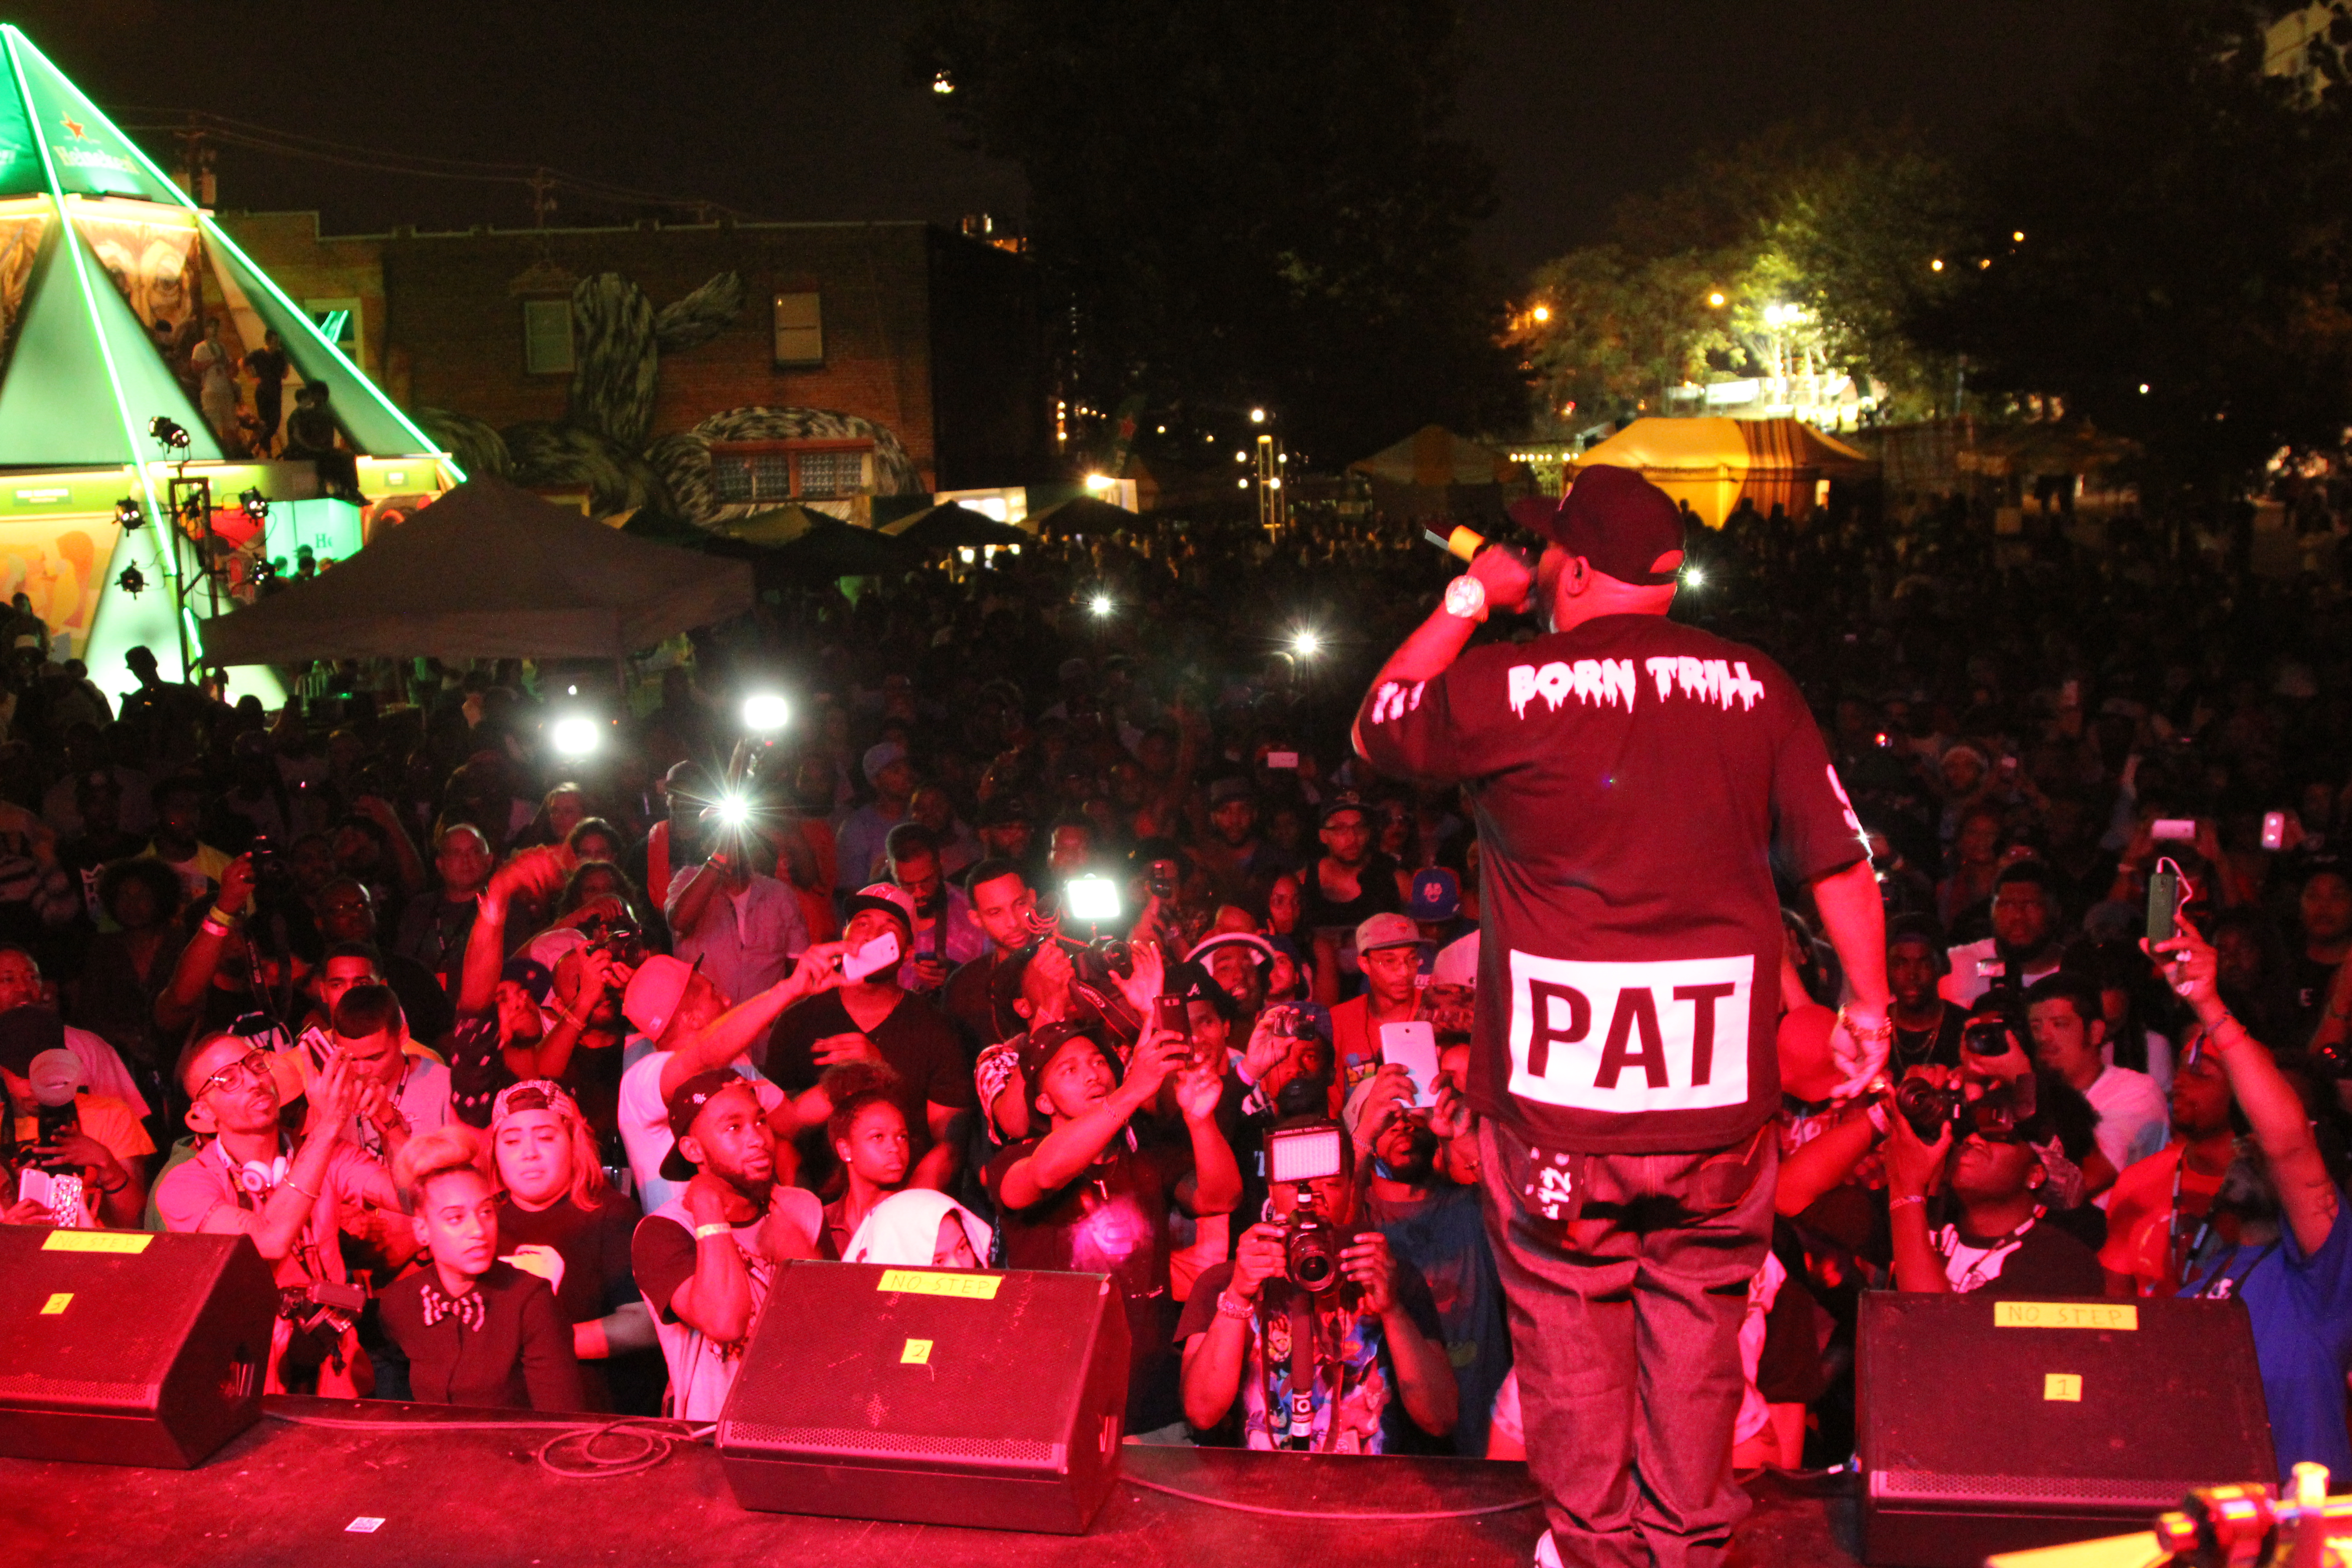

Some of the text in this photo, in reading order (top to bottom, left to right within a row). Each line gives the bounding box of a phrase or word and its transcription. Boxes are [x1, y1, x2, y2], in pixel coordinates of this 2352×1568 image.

[53, 146, 140, 176] Heineken
[1508, 656, 1765, 720] BORN TRILL
[1528, 981, 1735, 1090] PAT
[54, 1235, 136, 1249] NO STEP
[890, 1274, 990, 1294] NO STEP
[50, 1296, 65, 1311] 3
[2008, 1305, 2122, 1326] NO STEP
[911, 1344, 926, 1357] 2
[2056, 1378, 2070, 1396] 1
